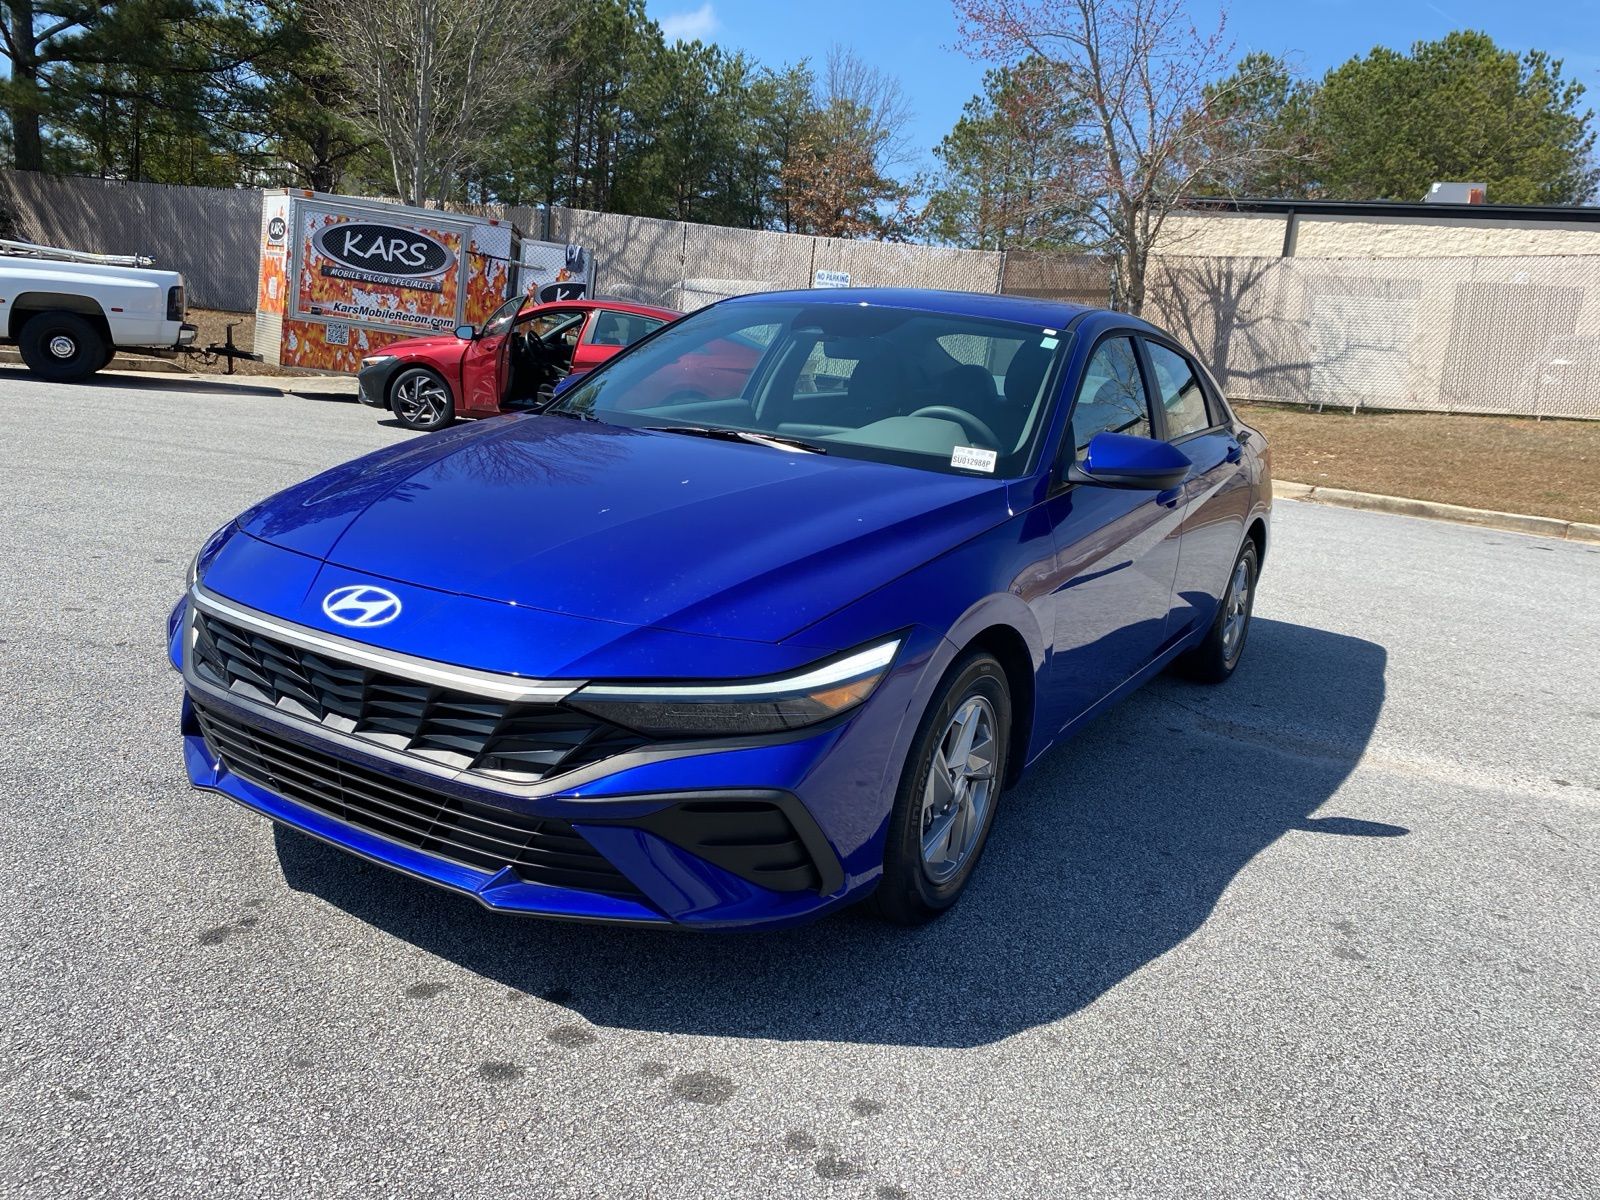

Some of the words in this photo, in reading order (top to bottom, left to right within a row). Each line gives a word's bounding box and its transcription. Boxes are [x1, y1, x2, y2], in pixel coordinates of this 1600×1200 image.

[343, 230, 428, 266] KARS
[330, 268, 361, 281] MOBILE
[362, 273, 390, 284] RECON
[390, 277, 434, 290] SPECIALIST
[827, 273, 848, 283] PARKING
[333, 302, 454, 328] KarsMobileRecon.com
